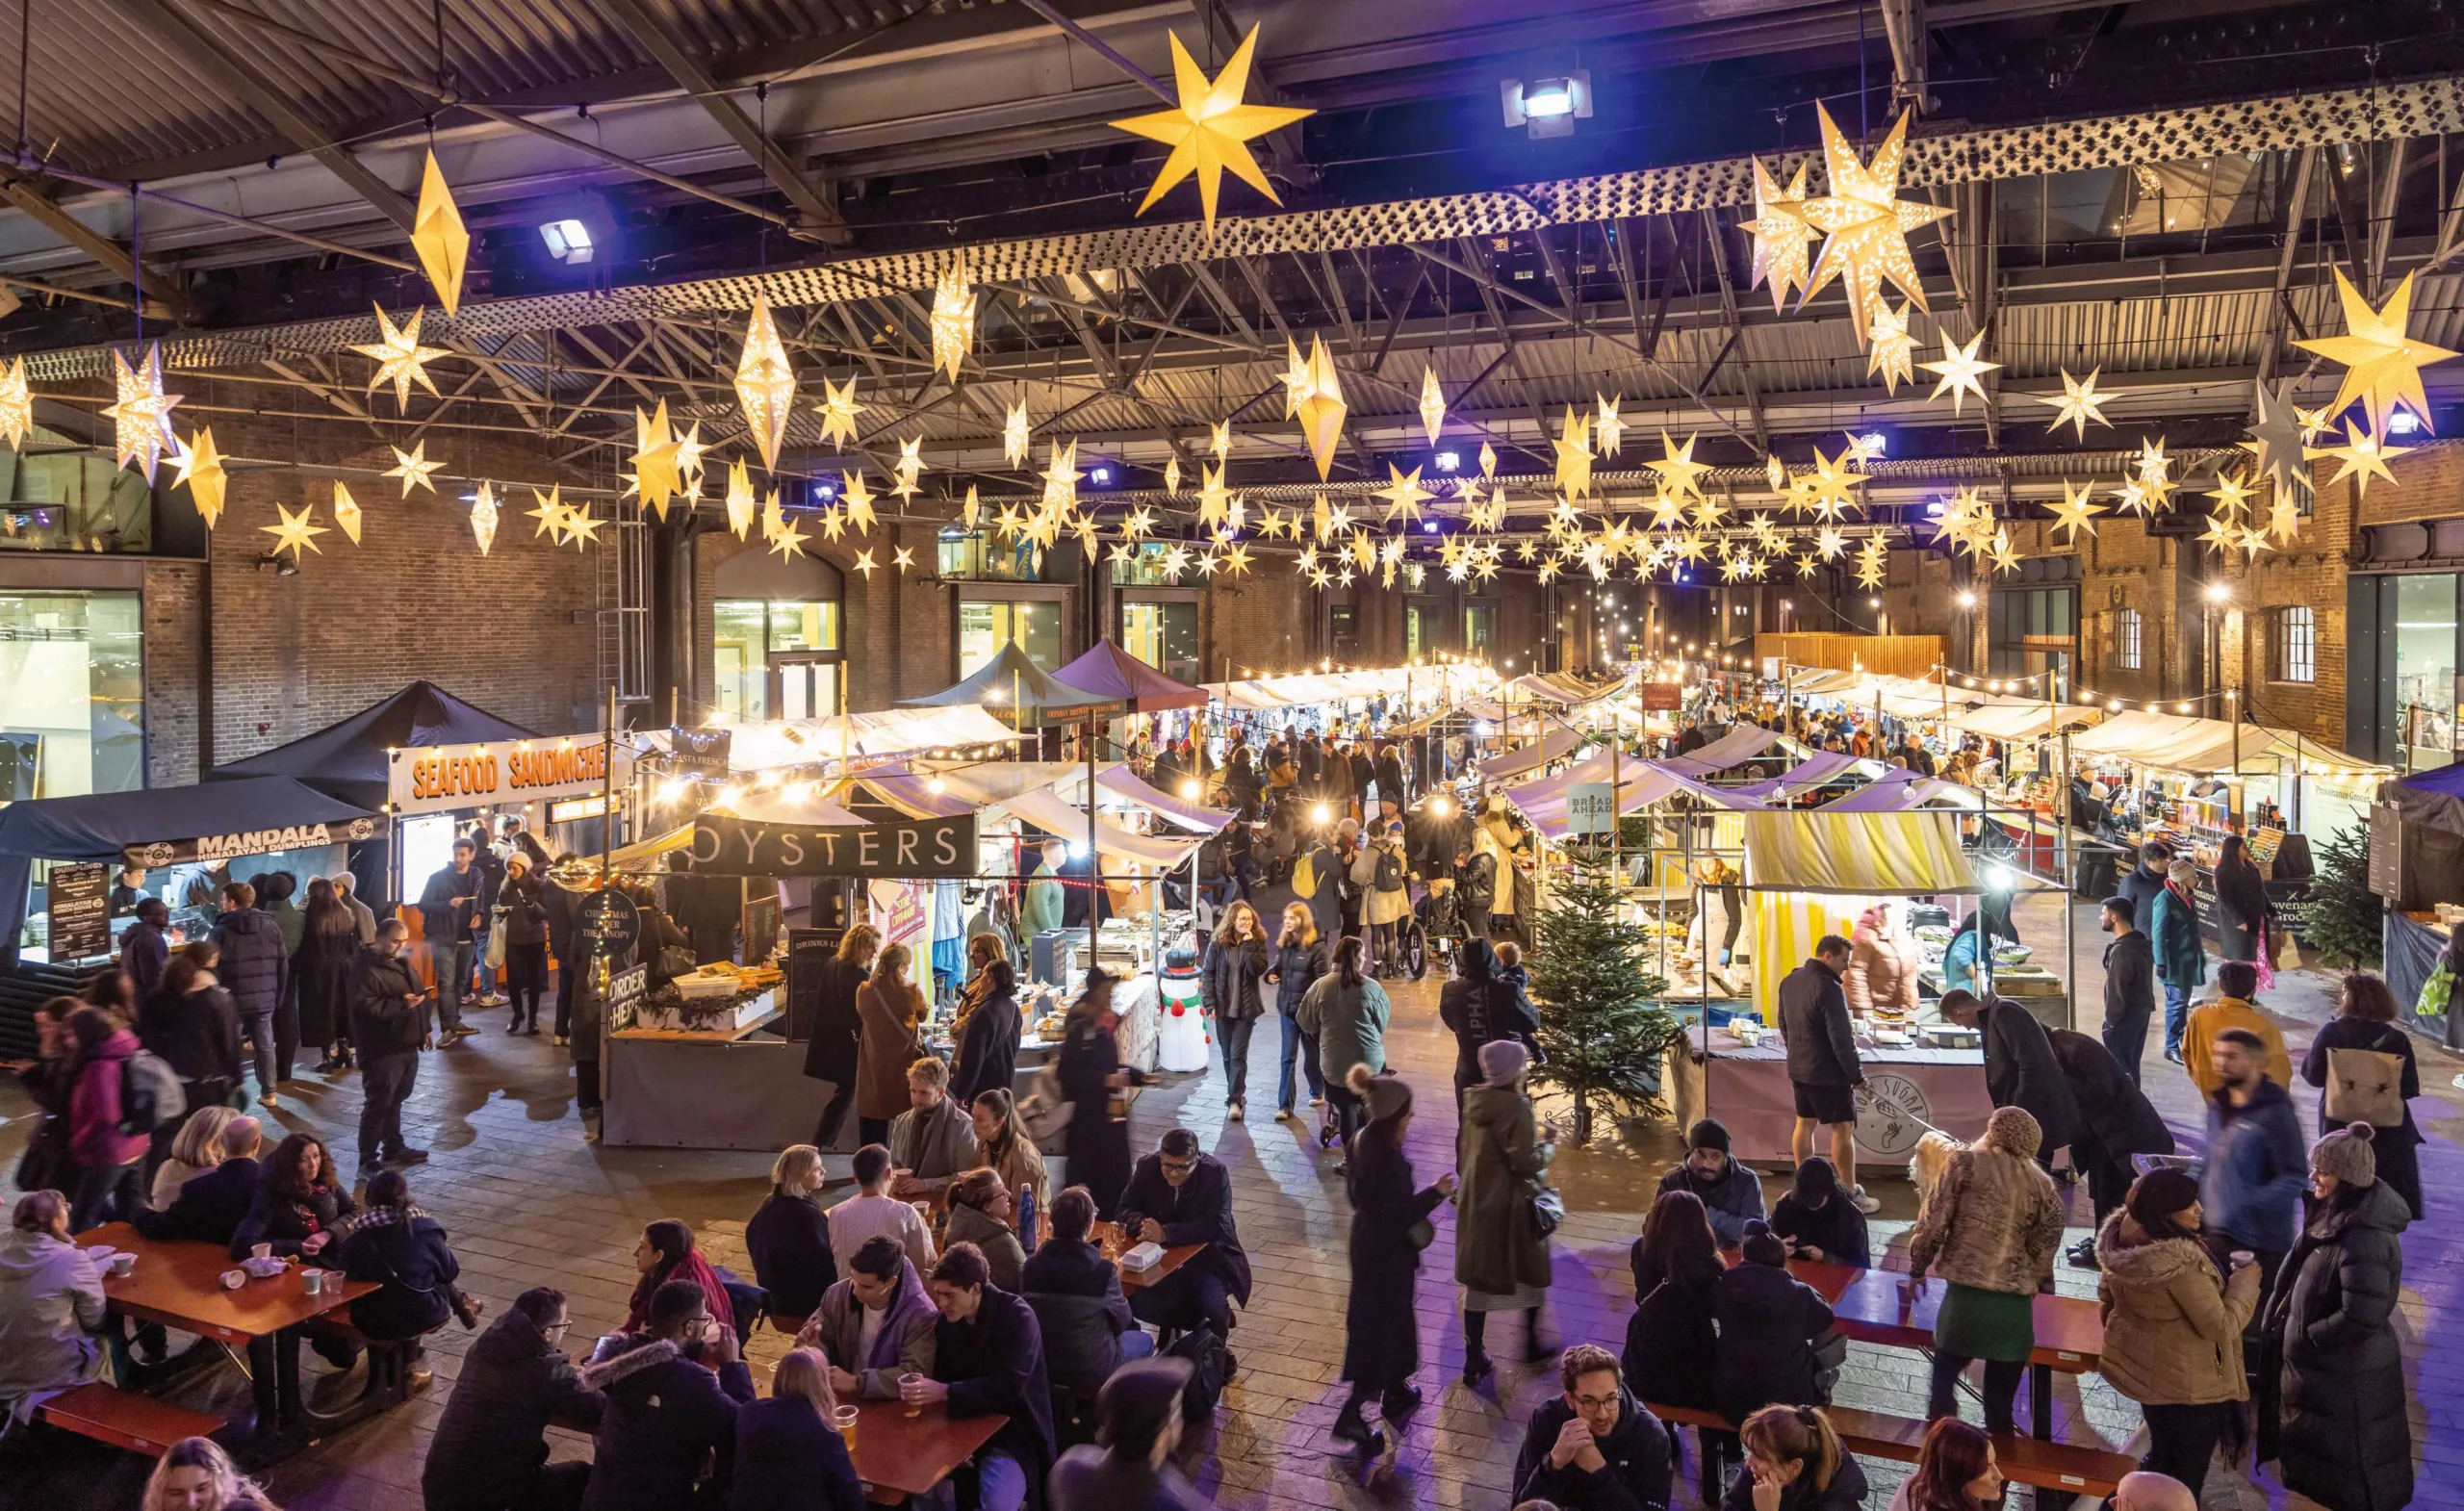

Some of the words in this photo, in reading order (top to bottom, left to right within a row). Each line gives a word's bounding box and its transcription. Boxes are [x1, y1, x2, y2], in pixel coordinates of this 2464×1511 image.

[1005, 709, 1025, 720] CHI
[673, 754, 697, 764] PASTA
[698, 756, 728, 766] FRESCA
[413, 754, 499, 800] SEAFOOD
[508, 744, 616, 789] SANDWICHE
[1572, 797, 1613, 807] BREAD
[2315, 784, 2349, 801] Provenance
[2348, 790, 2371, 804] Grocer
[1571, 806, 1613, 814] AHEAD
[197, 823, 330, 857] MANDALA
[693, 826, 957, 866] OYSTERS
[197, 845, 267, 861] HIMALAYAN
[269, 837, 332, 853] DUMPLINGS
[54, 862, 104, 875] DUMPLINGS
[2193, 887, 2216, 903] venance
[2194, 900, 2210, 911] rocer
[2272, 901, 2316, 910] ovenan
[796, 939, 829, 950] DRINKS
[830, 940, 839, 949] LI
[609, 969, 646, 1002] ORDER
[1467, 986, 1489, 1044] LPHA
[1884, 1078, 1924, 1114] SUGAR
